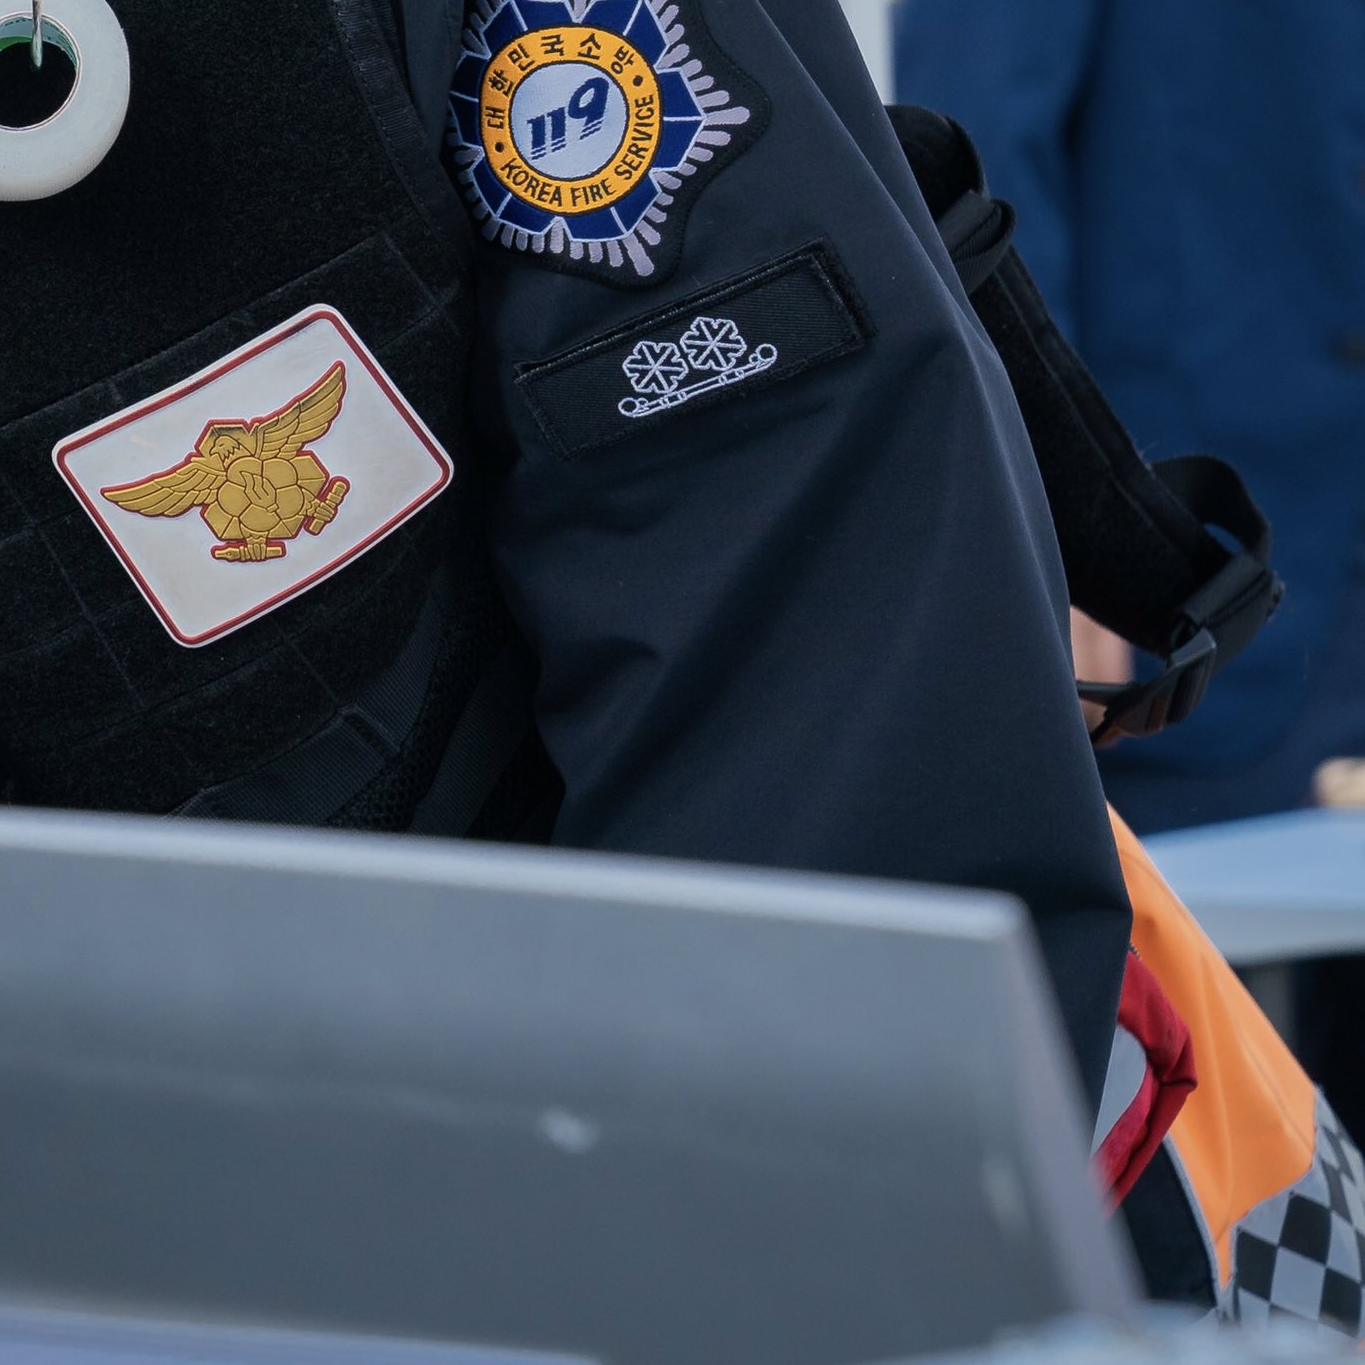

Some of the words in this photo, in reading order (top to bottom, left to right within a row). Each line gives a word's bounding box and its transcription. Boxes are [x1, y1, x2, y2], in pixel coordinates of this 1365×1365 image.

[500, 157, 563, 207] KOREA
[570, 178, 616, 207] FIRE
[614, 94, 655, 180] SERVICE
[526, 76, 610, 161] 119
